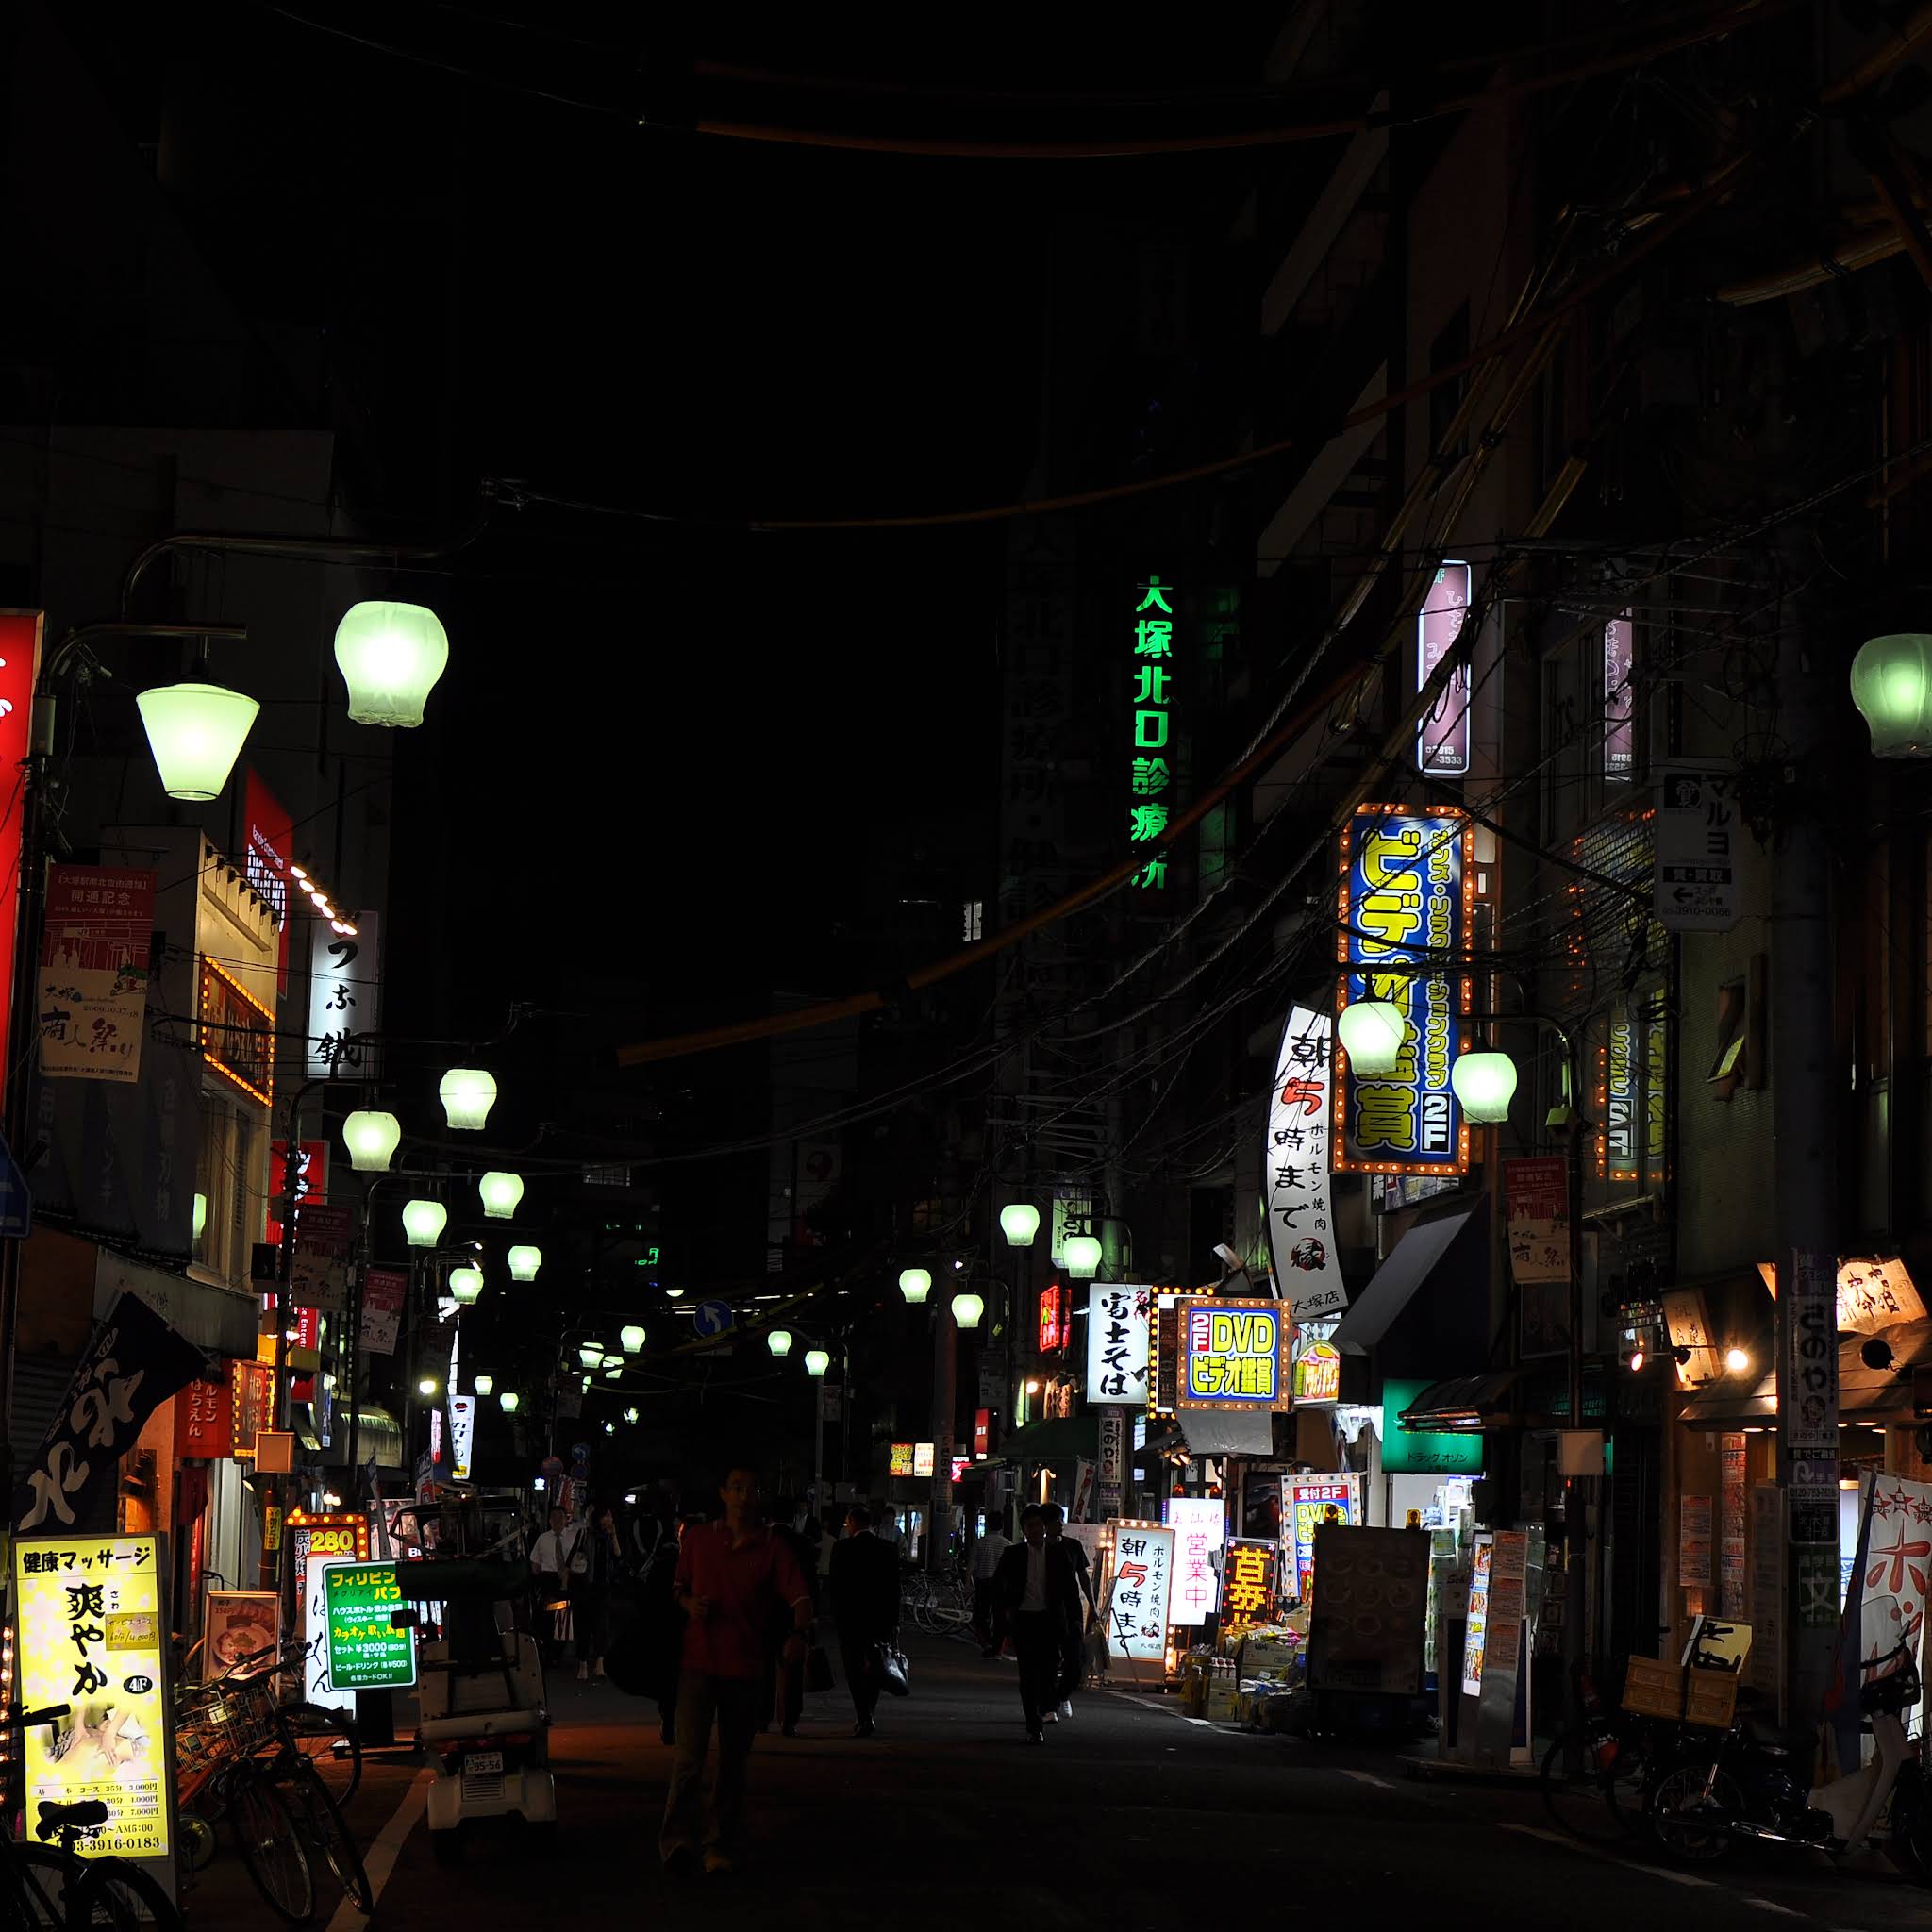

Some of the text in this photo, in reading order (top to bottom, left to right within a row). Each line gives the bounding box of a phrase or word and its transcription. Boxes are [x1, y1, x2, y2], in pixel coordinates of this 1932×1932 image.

[71, 889, 130, 906] 開通記念
[1424, 1095, 1448, 1150] 2F
[1309, 1123, 1327, 1231] ホルモン焼肉
[1291, 1291, 1340, 1314] 大塚店
[1100, 1292, 1131, 1396] 富士そば
[1192, 1313, 1274, 1353] 2F DVD
[1192, 1356, 1272, 1394] ビデオ鑑賞
[23, 1546, 151, 1574] 健康マッサージ
[310, 1529, 355, 1553] 280
[1149, 1546, 1165, 1618] ホルモン焼肉
[1185, 1533, 1208, 1608] 営業中
[110, 1590, 120, 1610] さわ
[65, 1582, 108, 1697] 爽やか
[128, 1677, 148, 1692] 4F
